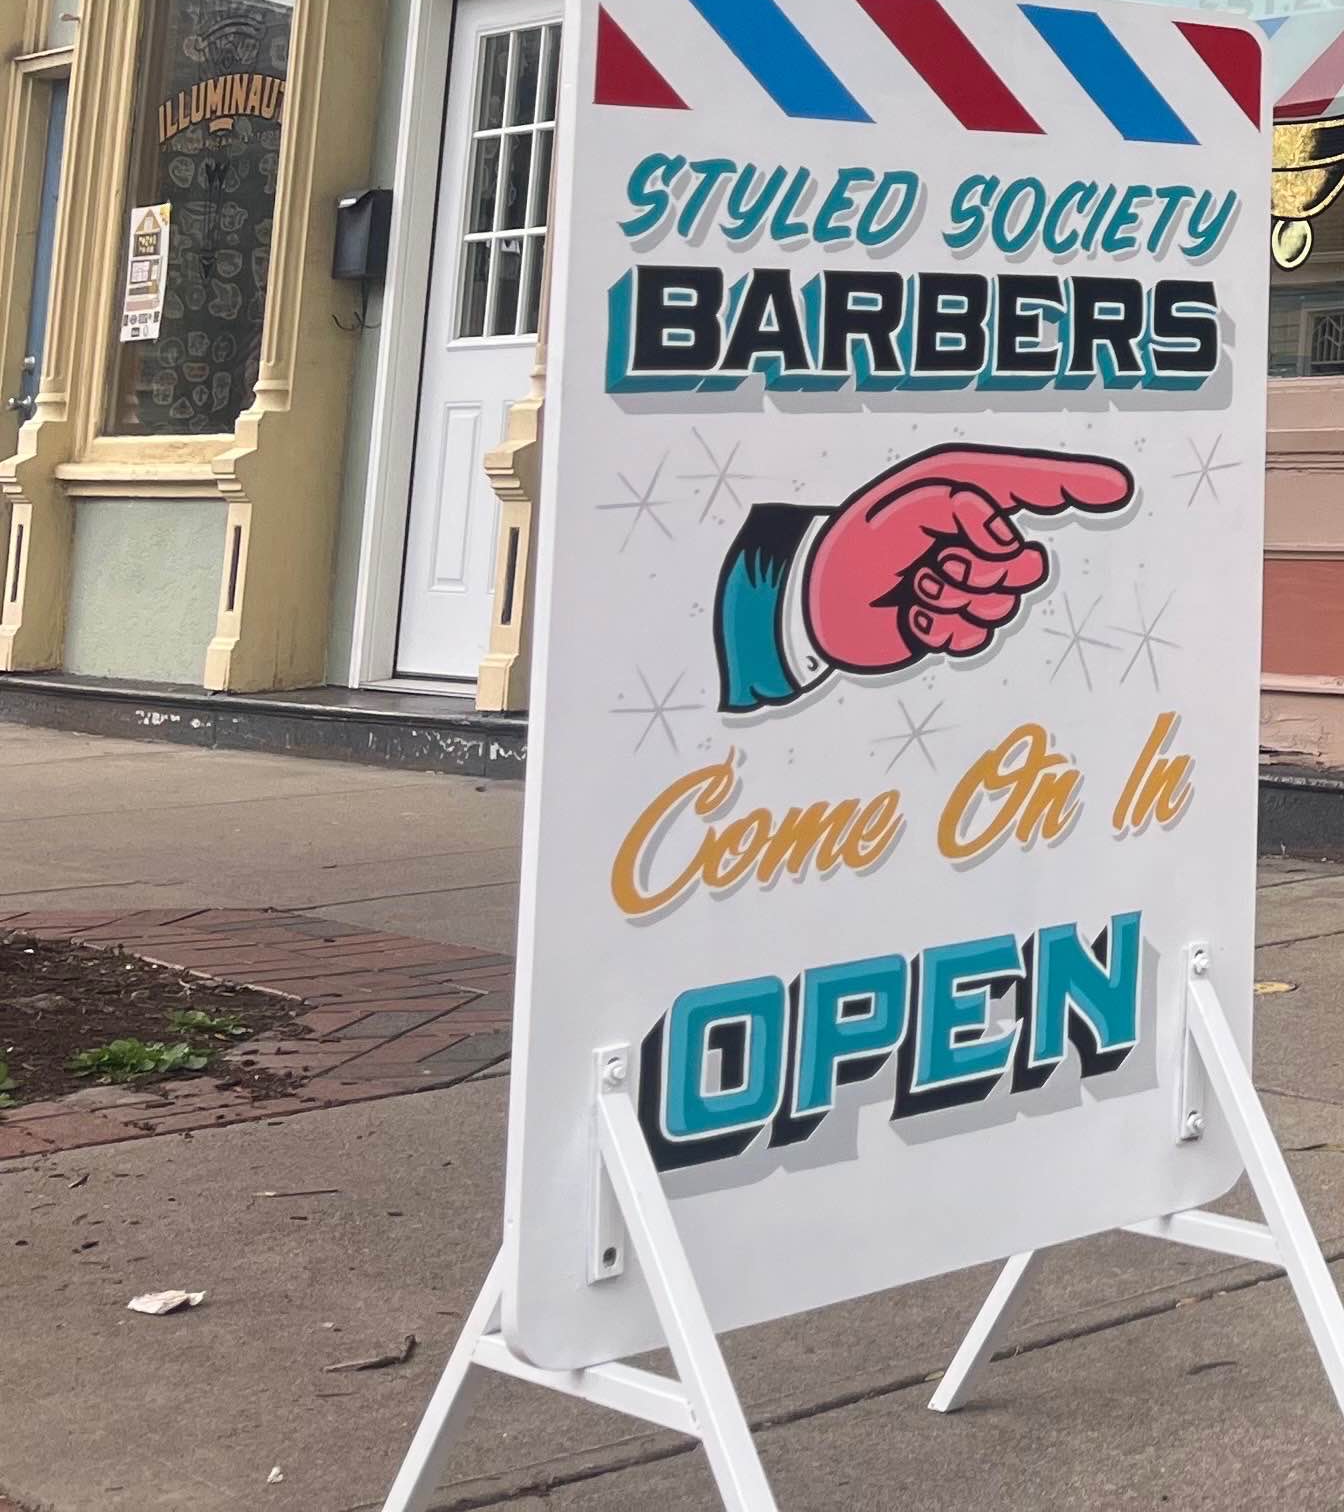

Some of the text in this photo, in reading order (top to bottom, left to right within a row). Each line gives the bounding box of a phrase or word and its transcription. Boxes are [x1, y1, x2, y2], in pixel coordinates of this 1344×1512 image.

[616, 152, 1238, 258] STYLED SOCIETY
[604, 264, 1222, 394] BARBERS
[610, 710, 1194, 916] Come On In
[638, 910, 1143, 1174] OPEN
